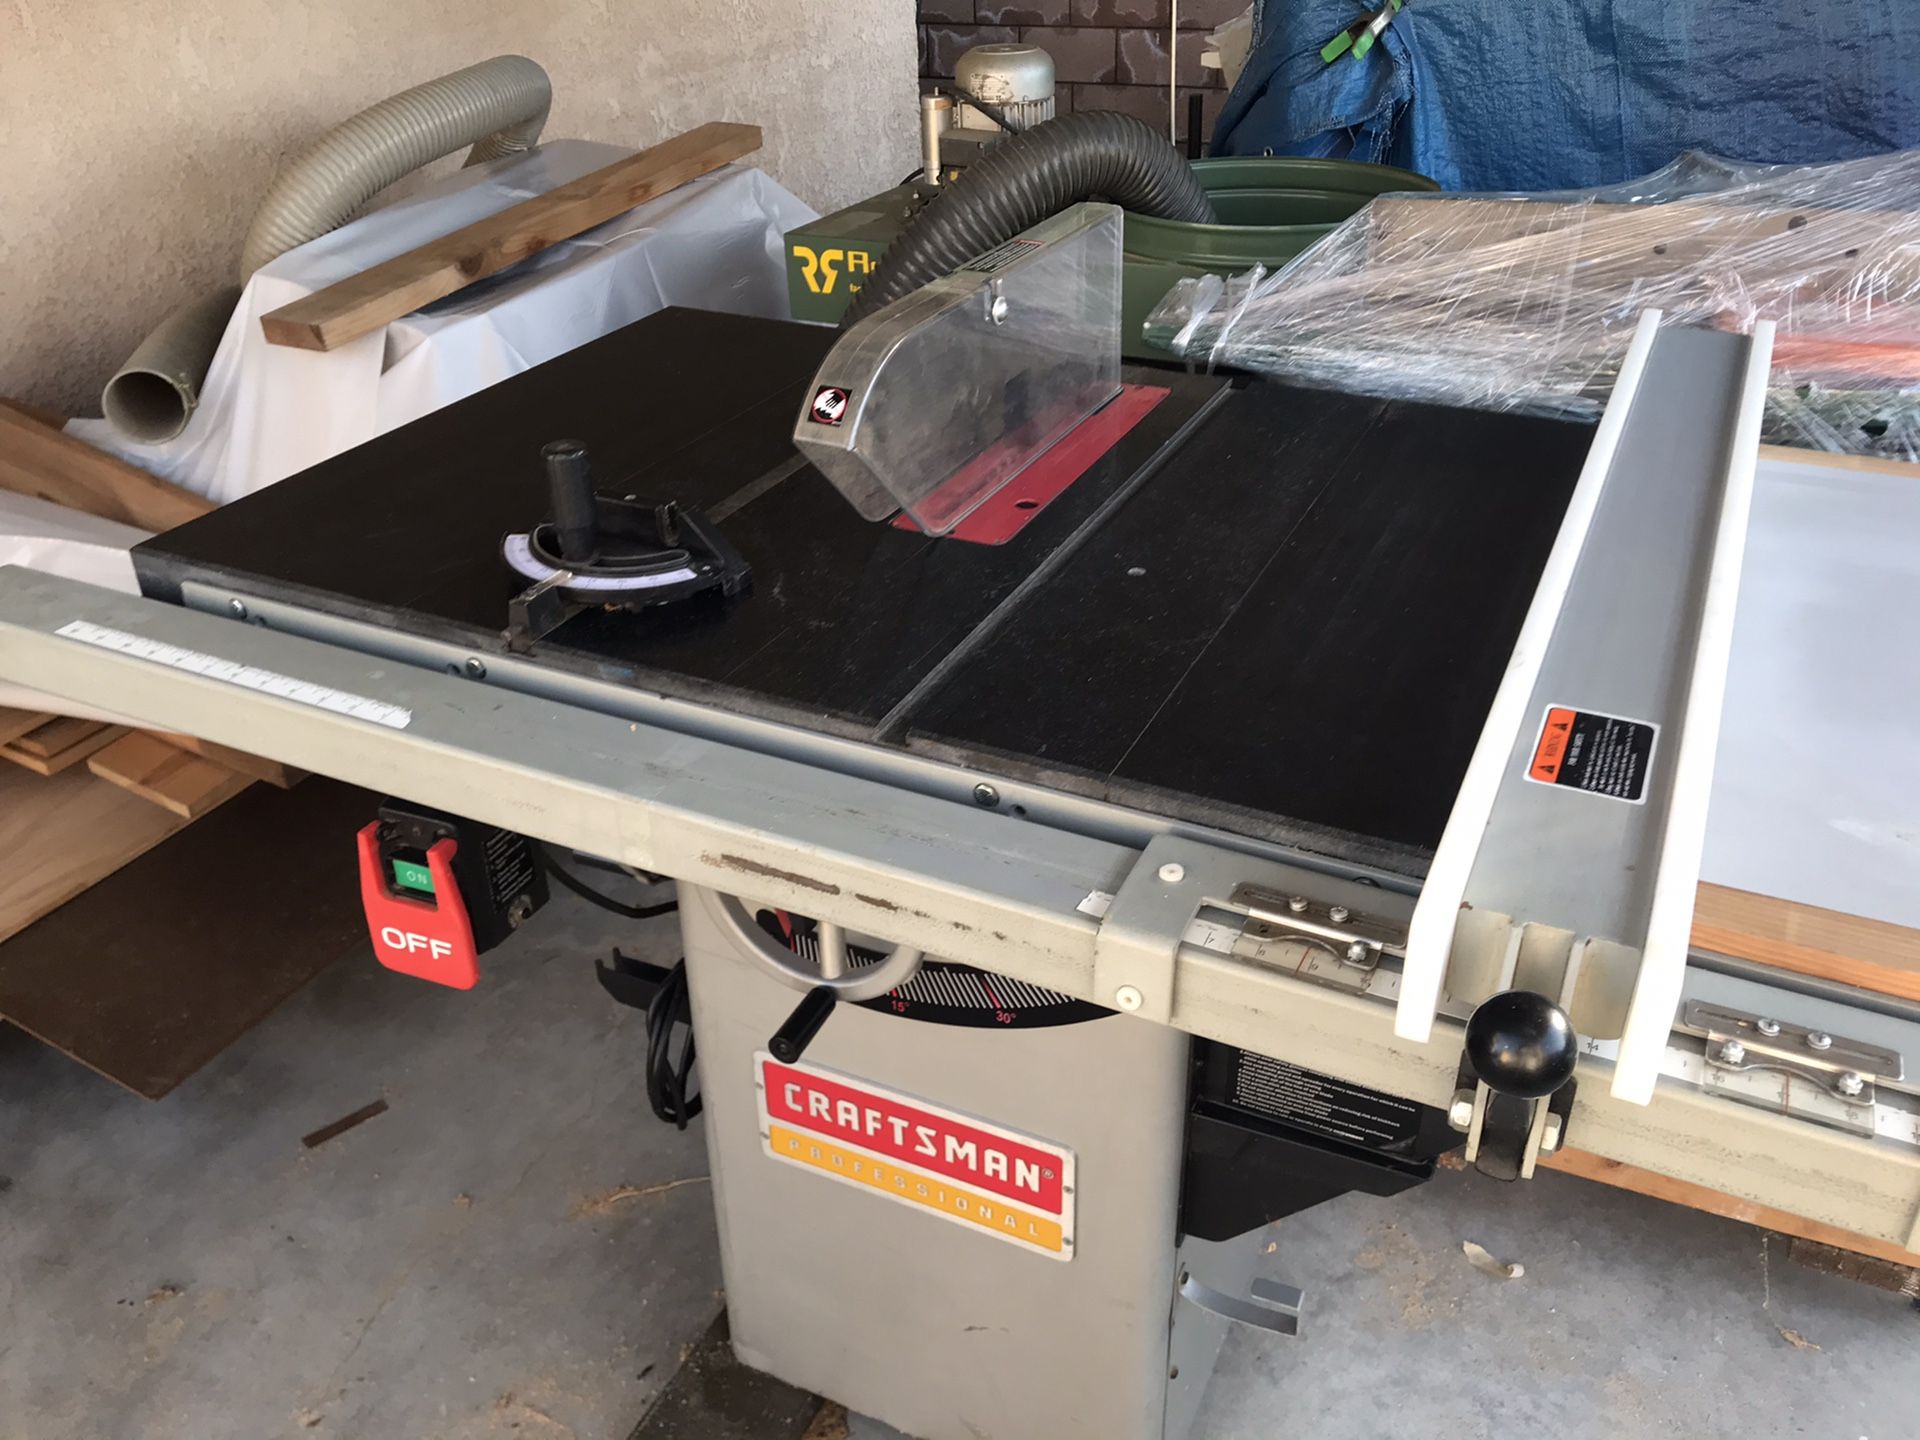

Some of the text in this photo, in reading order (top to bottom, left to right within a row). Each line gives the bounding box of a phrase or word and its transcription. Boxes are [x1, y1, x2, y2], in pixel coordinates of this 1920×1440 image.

[406, 870, 428, 885] ON
[381, 926, 453, 960] OFF
[788, 1138, 1039, 1237] PROFESSIONAL
